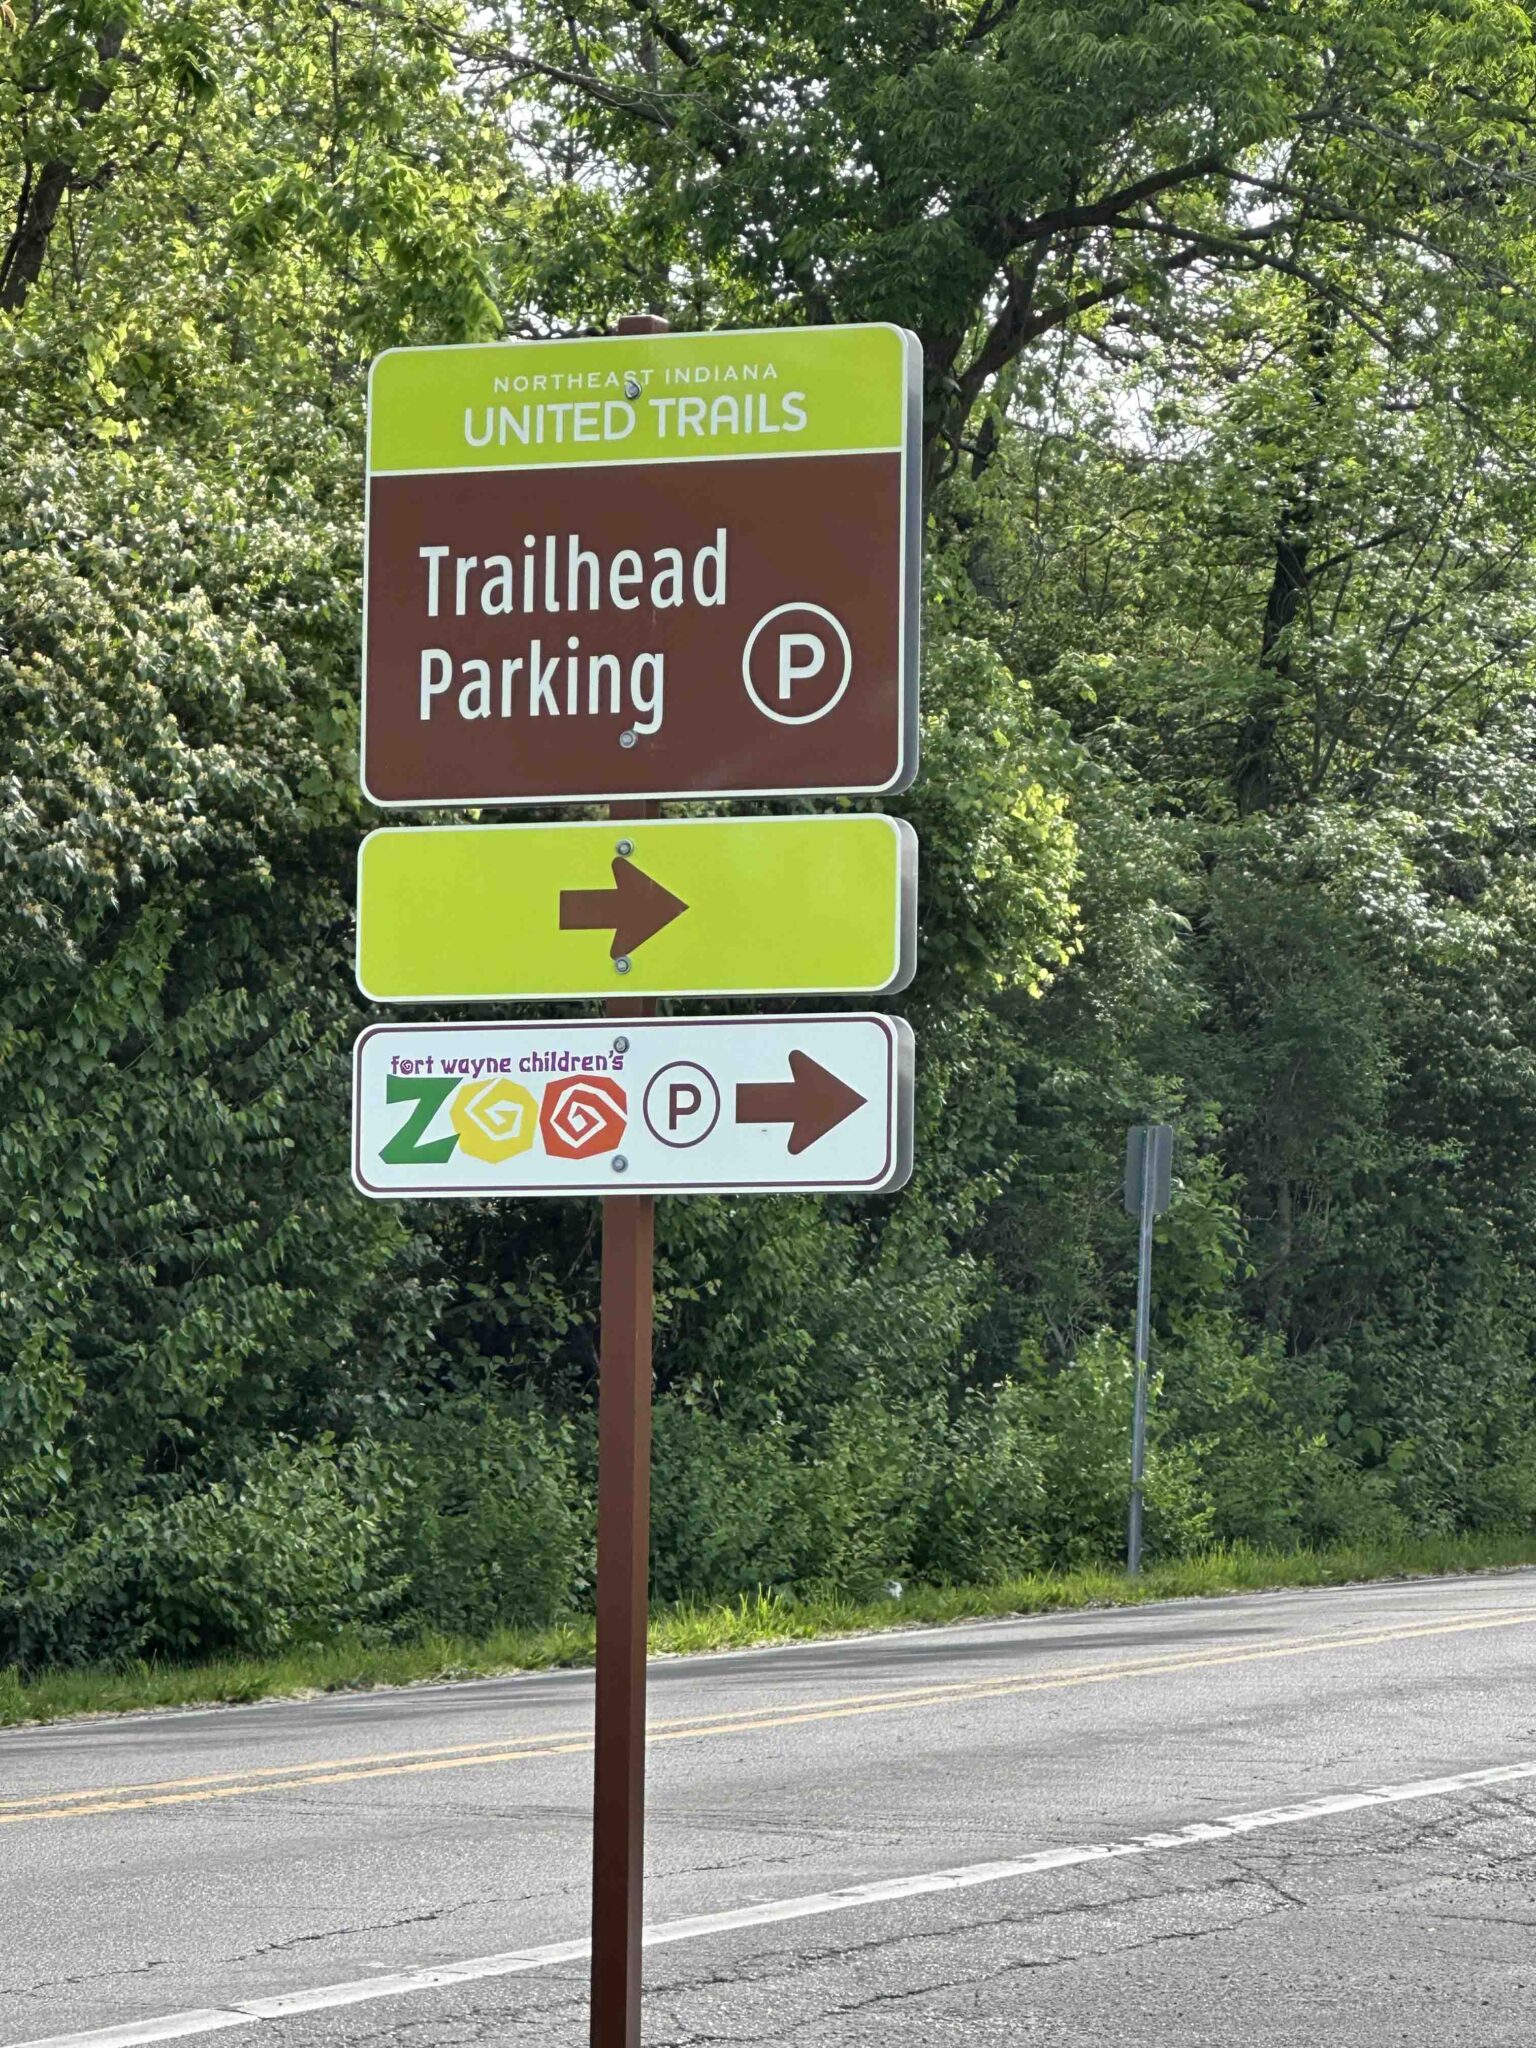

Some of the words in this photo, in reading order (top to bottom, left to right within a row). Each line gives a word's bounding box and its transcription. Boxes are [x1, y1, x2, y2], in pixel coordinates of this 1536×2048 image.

[494, 369, 654, 392] NORTHEAST
[665, 363, 779, 385] INDIANA
[464, 400, 636, 448] UNITED
[649, 392, 807, 438] TRAILS
[419, 527, 728, 617] Trailhead
[420, 636, 665, 735] Parking
[779, 633, 826, 699] P
[391, 1054, 434, 1075] fort
[440, 1055, 512, 1078] wayne
[519, 1050, 624, 1073] children's
[668, 1084, 702, 1130] P
